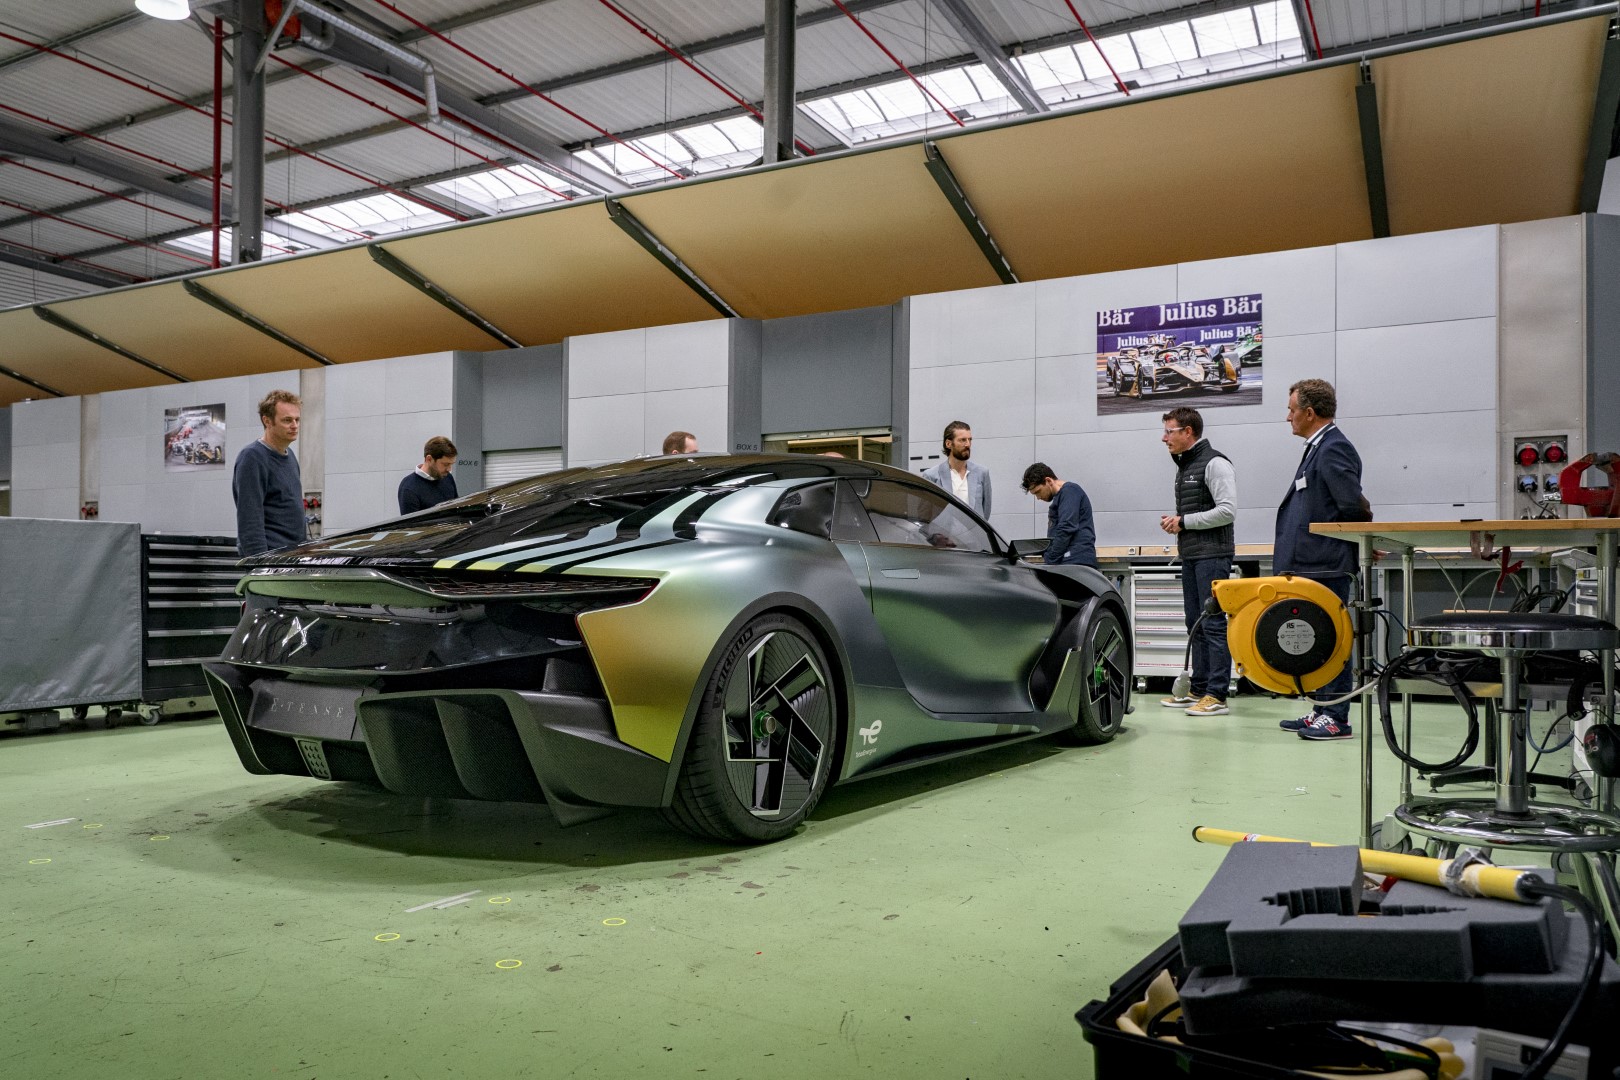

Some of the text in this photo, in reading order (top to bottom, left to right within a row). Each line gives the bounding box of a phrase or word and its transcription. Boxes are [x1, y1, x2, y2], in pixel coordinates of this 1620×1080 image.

[1098, 309, 1134, 327] Bär
[1159, 296, 1262, 326] Julius Bär
[1117, 335, 1149, 349] Julius
[1200, 328, 1234, 342] Julius
[736, 443, 752, 451] BOX
